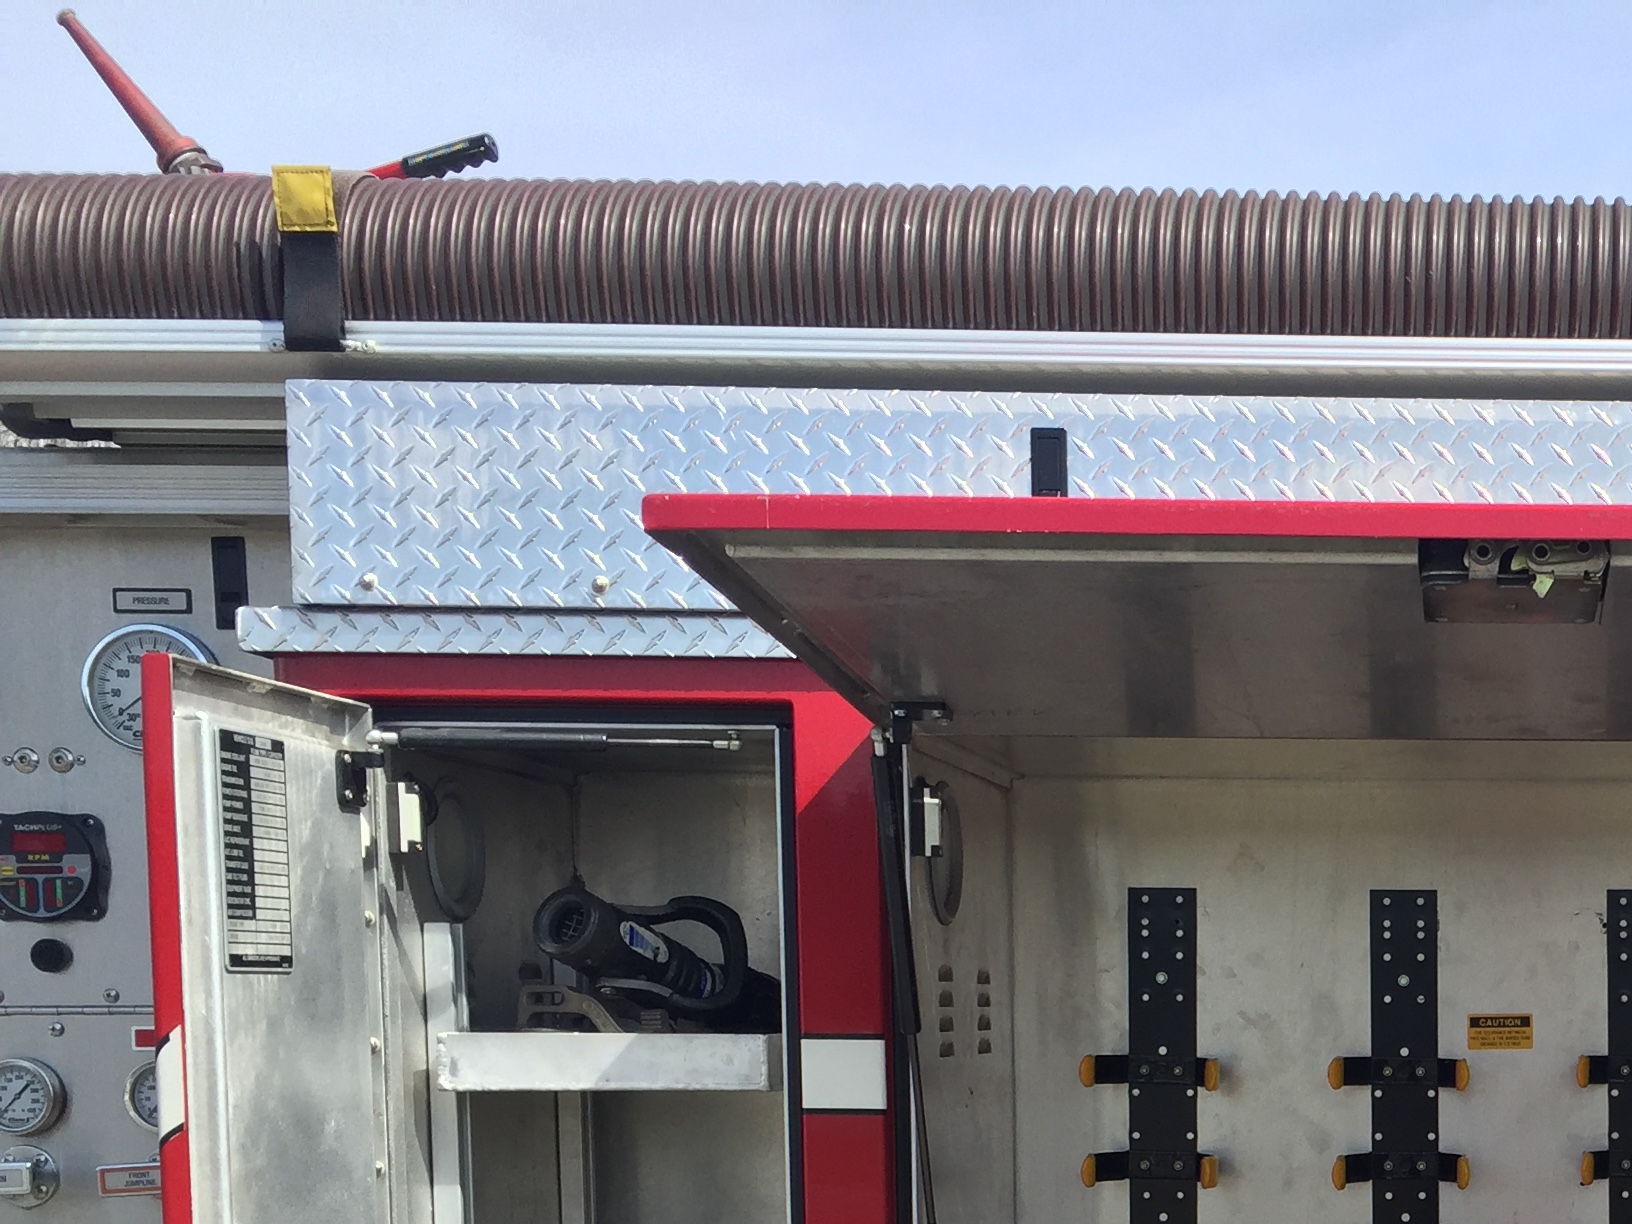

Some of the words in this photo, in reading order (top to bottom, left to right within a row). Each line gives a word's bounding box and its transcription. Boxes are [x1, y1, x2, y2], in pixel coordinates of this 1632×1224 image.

[132, 596, 170, 606] PRESSURE
[116, 669, 130, 678] 100
[110, 688, 121, 697] 50
[1479, 1018, 1521, 1027] CAUTION
